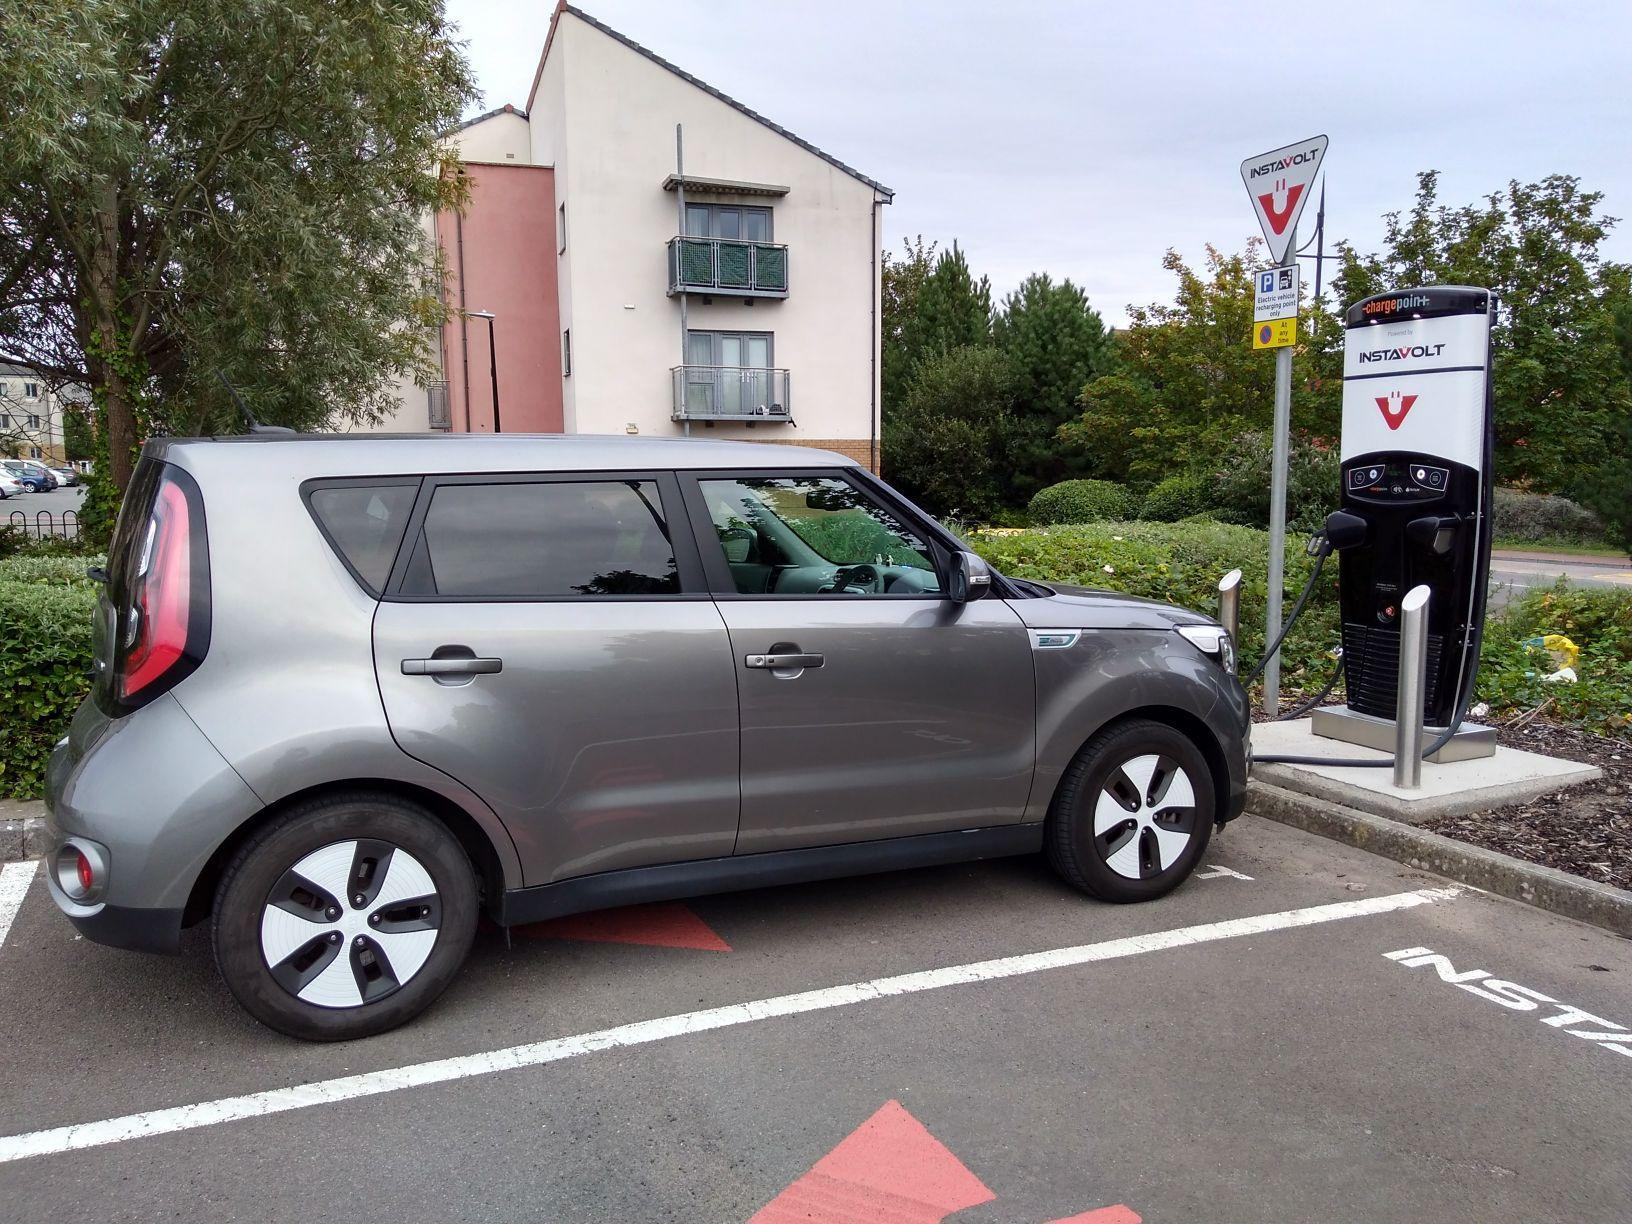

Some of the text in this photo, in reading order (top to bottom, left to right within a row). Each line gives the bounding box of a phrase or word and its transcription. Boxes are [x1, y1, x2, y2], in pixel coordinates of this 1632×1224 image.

[1250, 148, 1319, 179] INSTAVOLT
[1263, 274, 1273, 292] P
[1255, 300, 1296, 312] recharging point
[1257, 292, 1296, 304] Electric vehicle
[1359, 343, 1446, 364] INSTAVOLT
